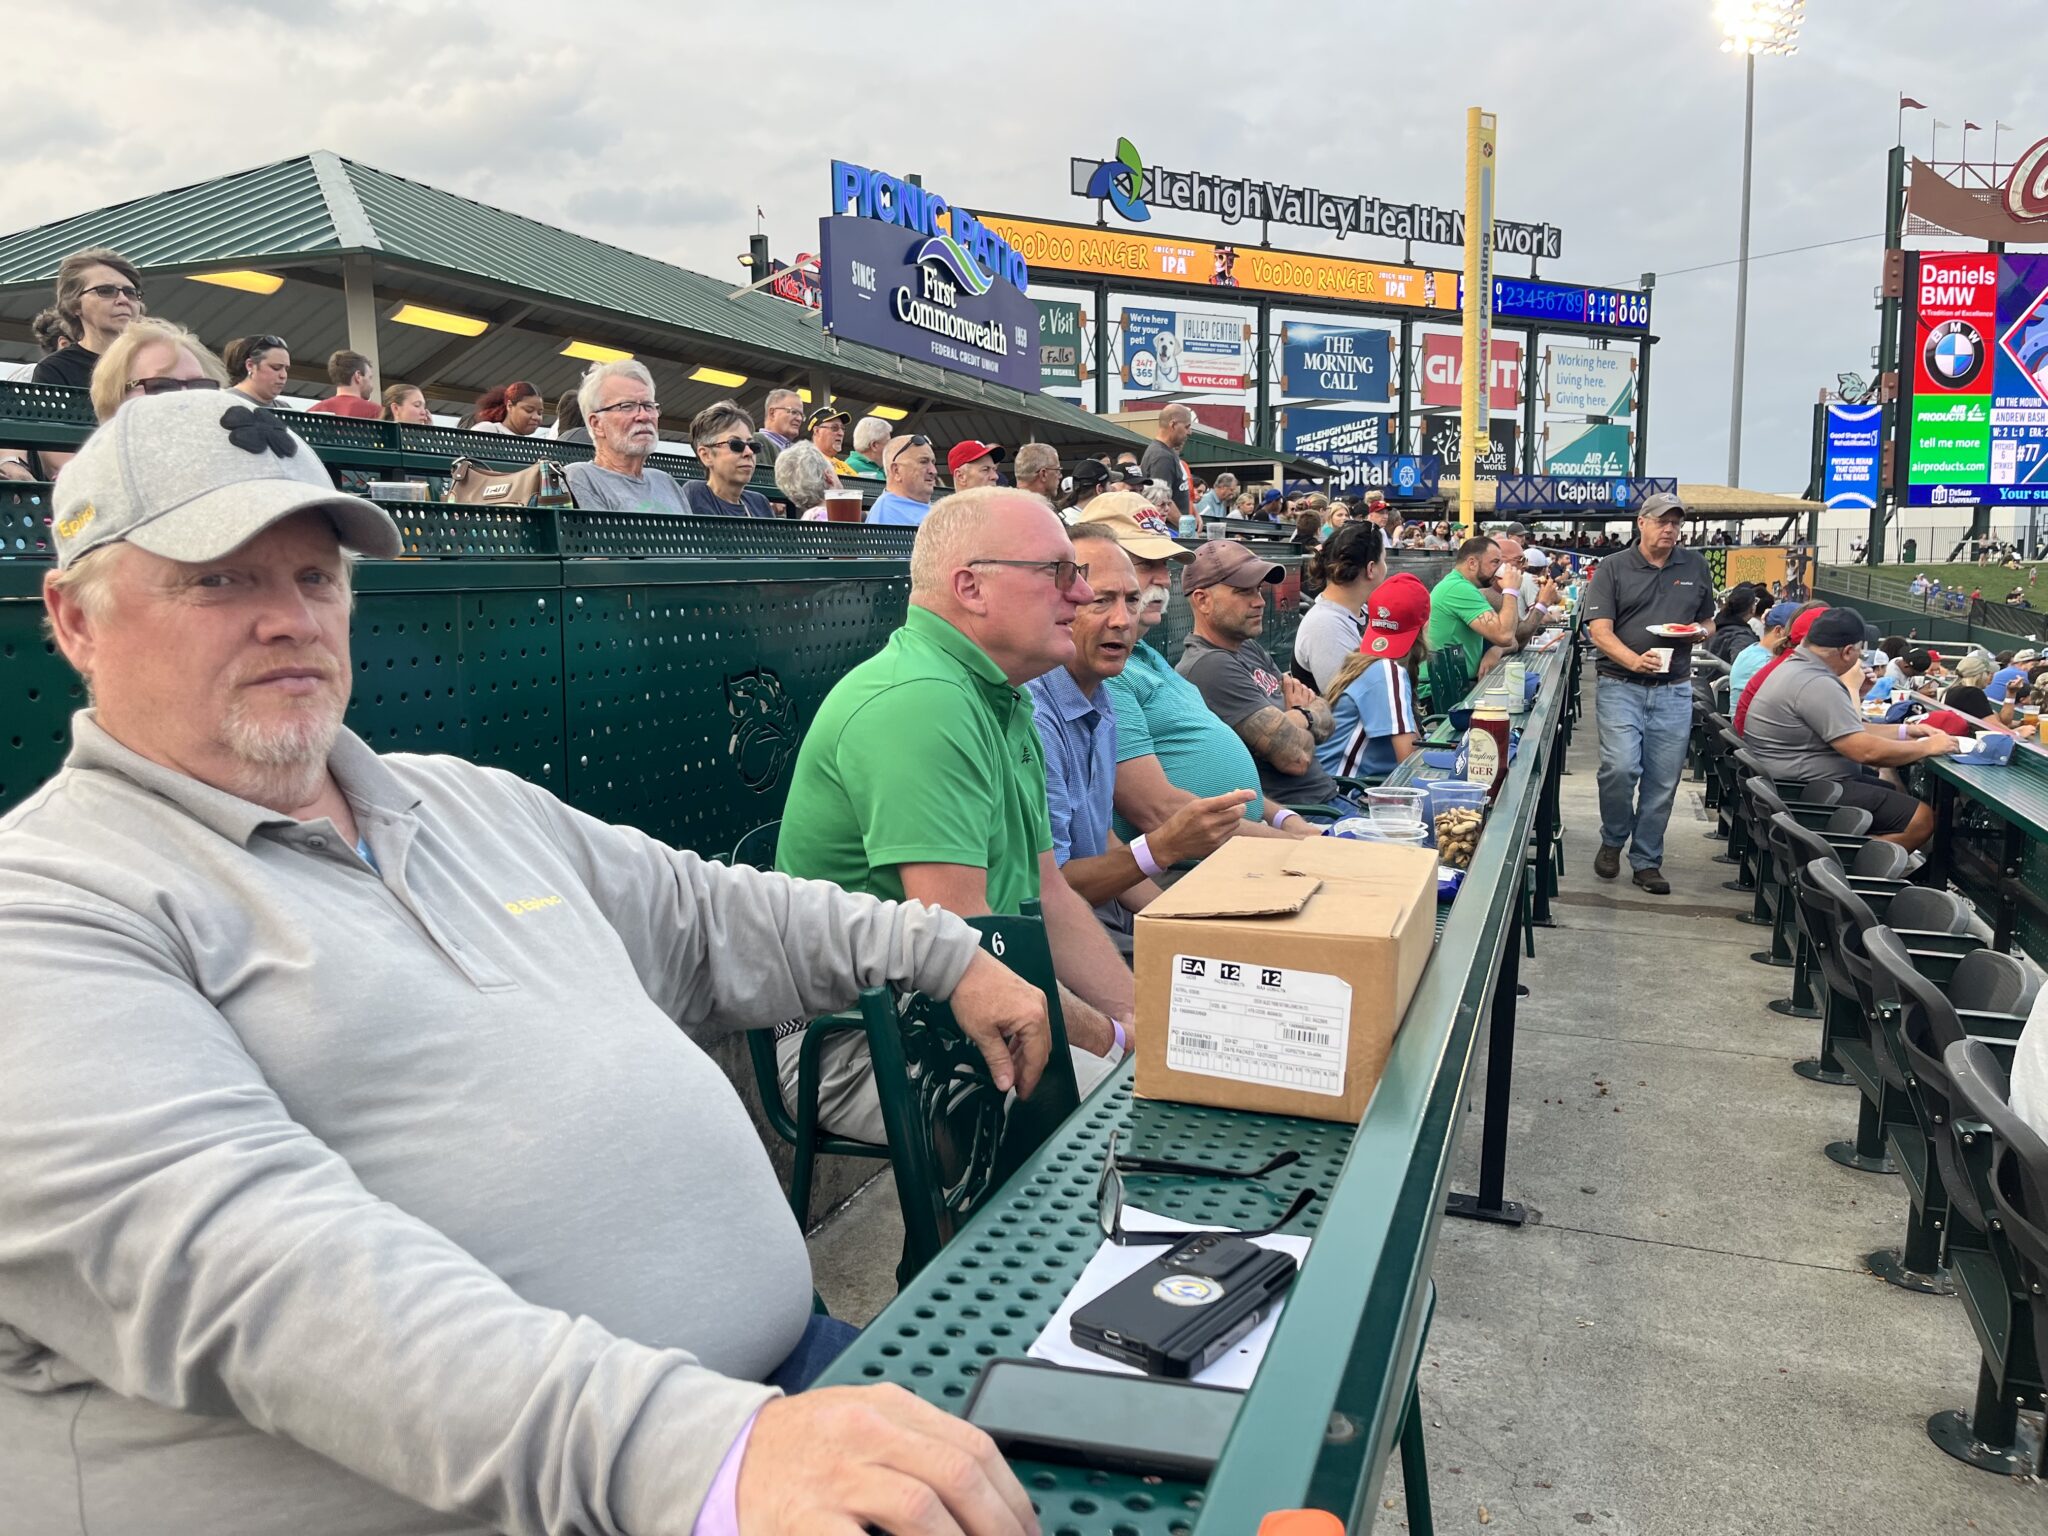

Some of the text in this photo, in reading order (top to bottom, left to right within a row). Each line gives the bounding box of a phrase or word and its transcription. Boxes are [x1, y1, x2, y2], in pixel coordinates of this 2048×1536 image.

[1152, 166, 1262, 224] Lehigh
[1263, 182, 1354, 240] Valley
[1358, 195, 1447, 243] Health
[832, 160, 1029, 294] PICNIC PATIO
[997, 227, 1149, 270] VOODOO RANGER
[1162, 256, 1187, 275] IPA
[1922, 264, 1995, 285] Daniels
[852, 260, 876, 292] SINCE
[1252, 257, 1375, 294] VOODOO RANGER
[1479, 233, 1491, 320] Painting
[922, 265, 956, 309] First
[1385, 281, 1405, 299] IPA
[1921, 286, 1975, 306] BMW
[897, 286, 1008, 356] Commonwealth
[1049, 307, 1075, 335] Visit
[1130, 313, 1169, 325] We're here
[1130, 325, 1159, 336] for your
[1184, 319, 1242, 342] VALLEY CENTRAL
[1130, 336, 1146, 346] pet!
[1323, 335, 1354, 355] THE
[931, 341, 999, 373] FEDERAL CREDIT UNION
[1047, 348, 1070, 364] Falls
[1136, 359, 1153, 367] 24/7
[1303, 352, 1374, 374] MORNING
[1557, 353, 1619, 371] Working here.
[1136, 368, 1153, 378] 365
[1187, 375, 1237, 386] vcvrec.com
[1320, 371, 1358, 391] CALL
[1556, 372, 1606, 390] Living here.
[1556, 391, 1609, 409] Giving here.
[1995, 397, 2042, 408] ON THE MOUND
[1917, 412, 1966, 422] PRODUCTS
[1995, 412, 2025, 423] ANDREW
[1296, 416, 1379, 445] THE LEHIGH VALLEY'S
[1330, 426, 1379, 449] SOURCE
[2002, 428, 2008, 437] 2
[1919, 437, 1981, 449] tell me more
[2016, 443, 2040, 462] #77
[1450, 451, 1507, 464] LASCAPE
[1483, 463, 1507, 471] works
[1584, 452, 1603, 464] AIR
[1912, 460, 1986, 474] airproducts.com
[1551, 463, 1602, 476] PRODUCTS
[1557, 480, 1610, 505] Capital
[1999, 487, 2031, 500] Your
[992, 931, 1005, 956] 6
[1182, 959, 1204, 974] EA
[1221, 965, 1240, 979] 12
[1262, 971, 1281, 985] 12
